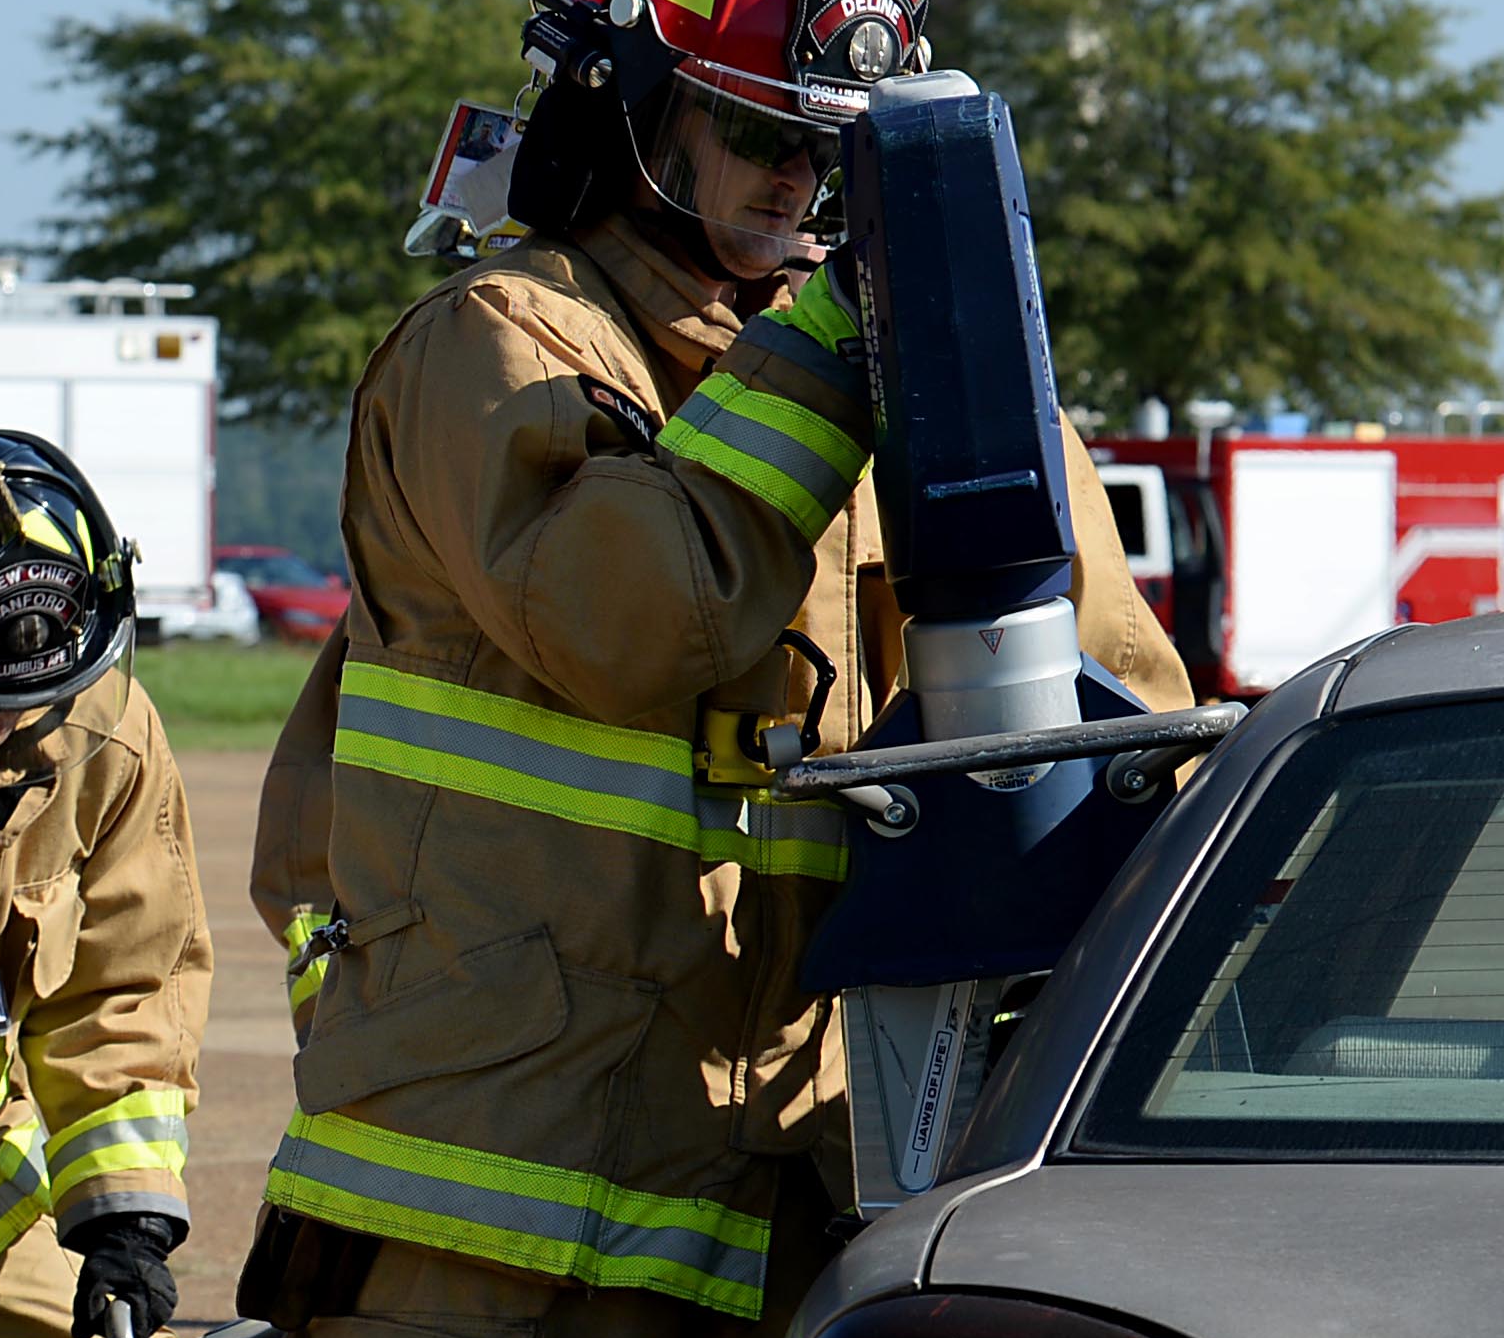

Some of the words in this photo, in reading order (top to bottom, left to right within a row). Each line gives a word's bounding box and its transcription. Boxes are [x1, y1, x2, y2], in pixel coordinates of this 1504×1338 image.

[809, 83, 869, 111] COLUMB
[27, 564, 77, 585] CHIEF
[917, 1101, 935, 1146] JAWS
[927, 1077, 939, 1099] OF
